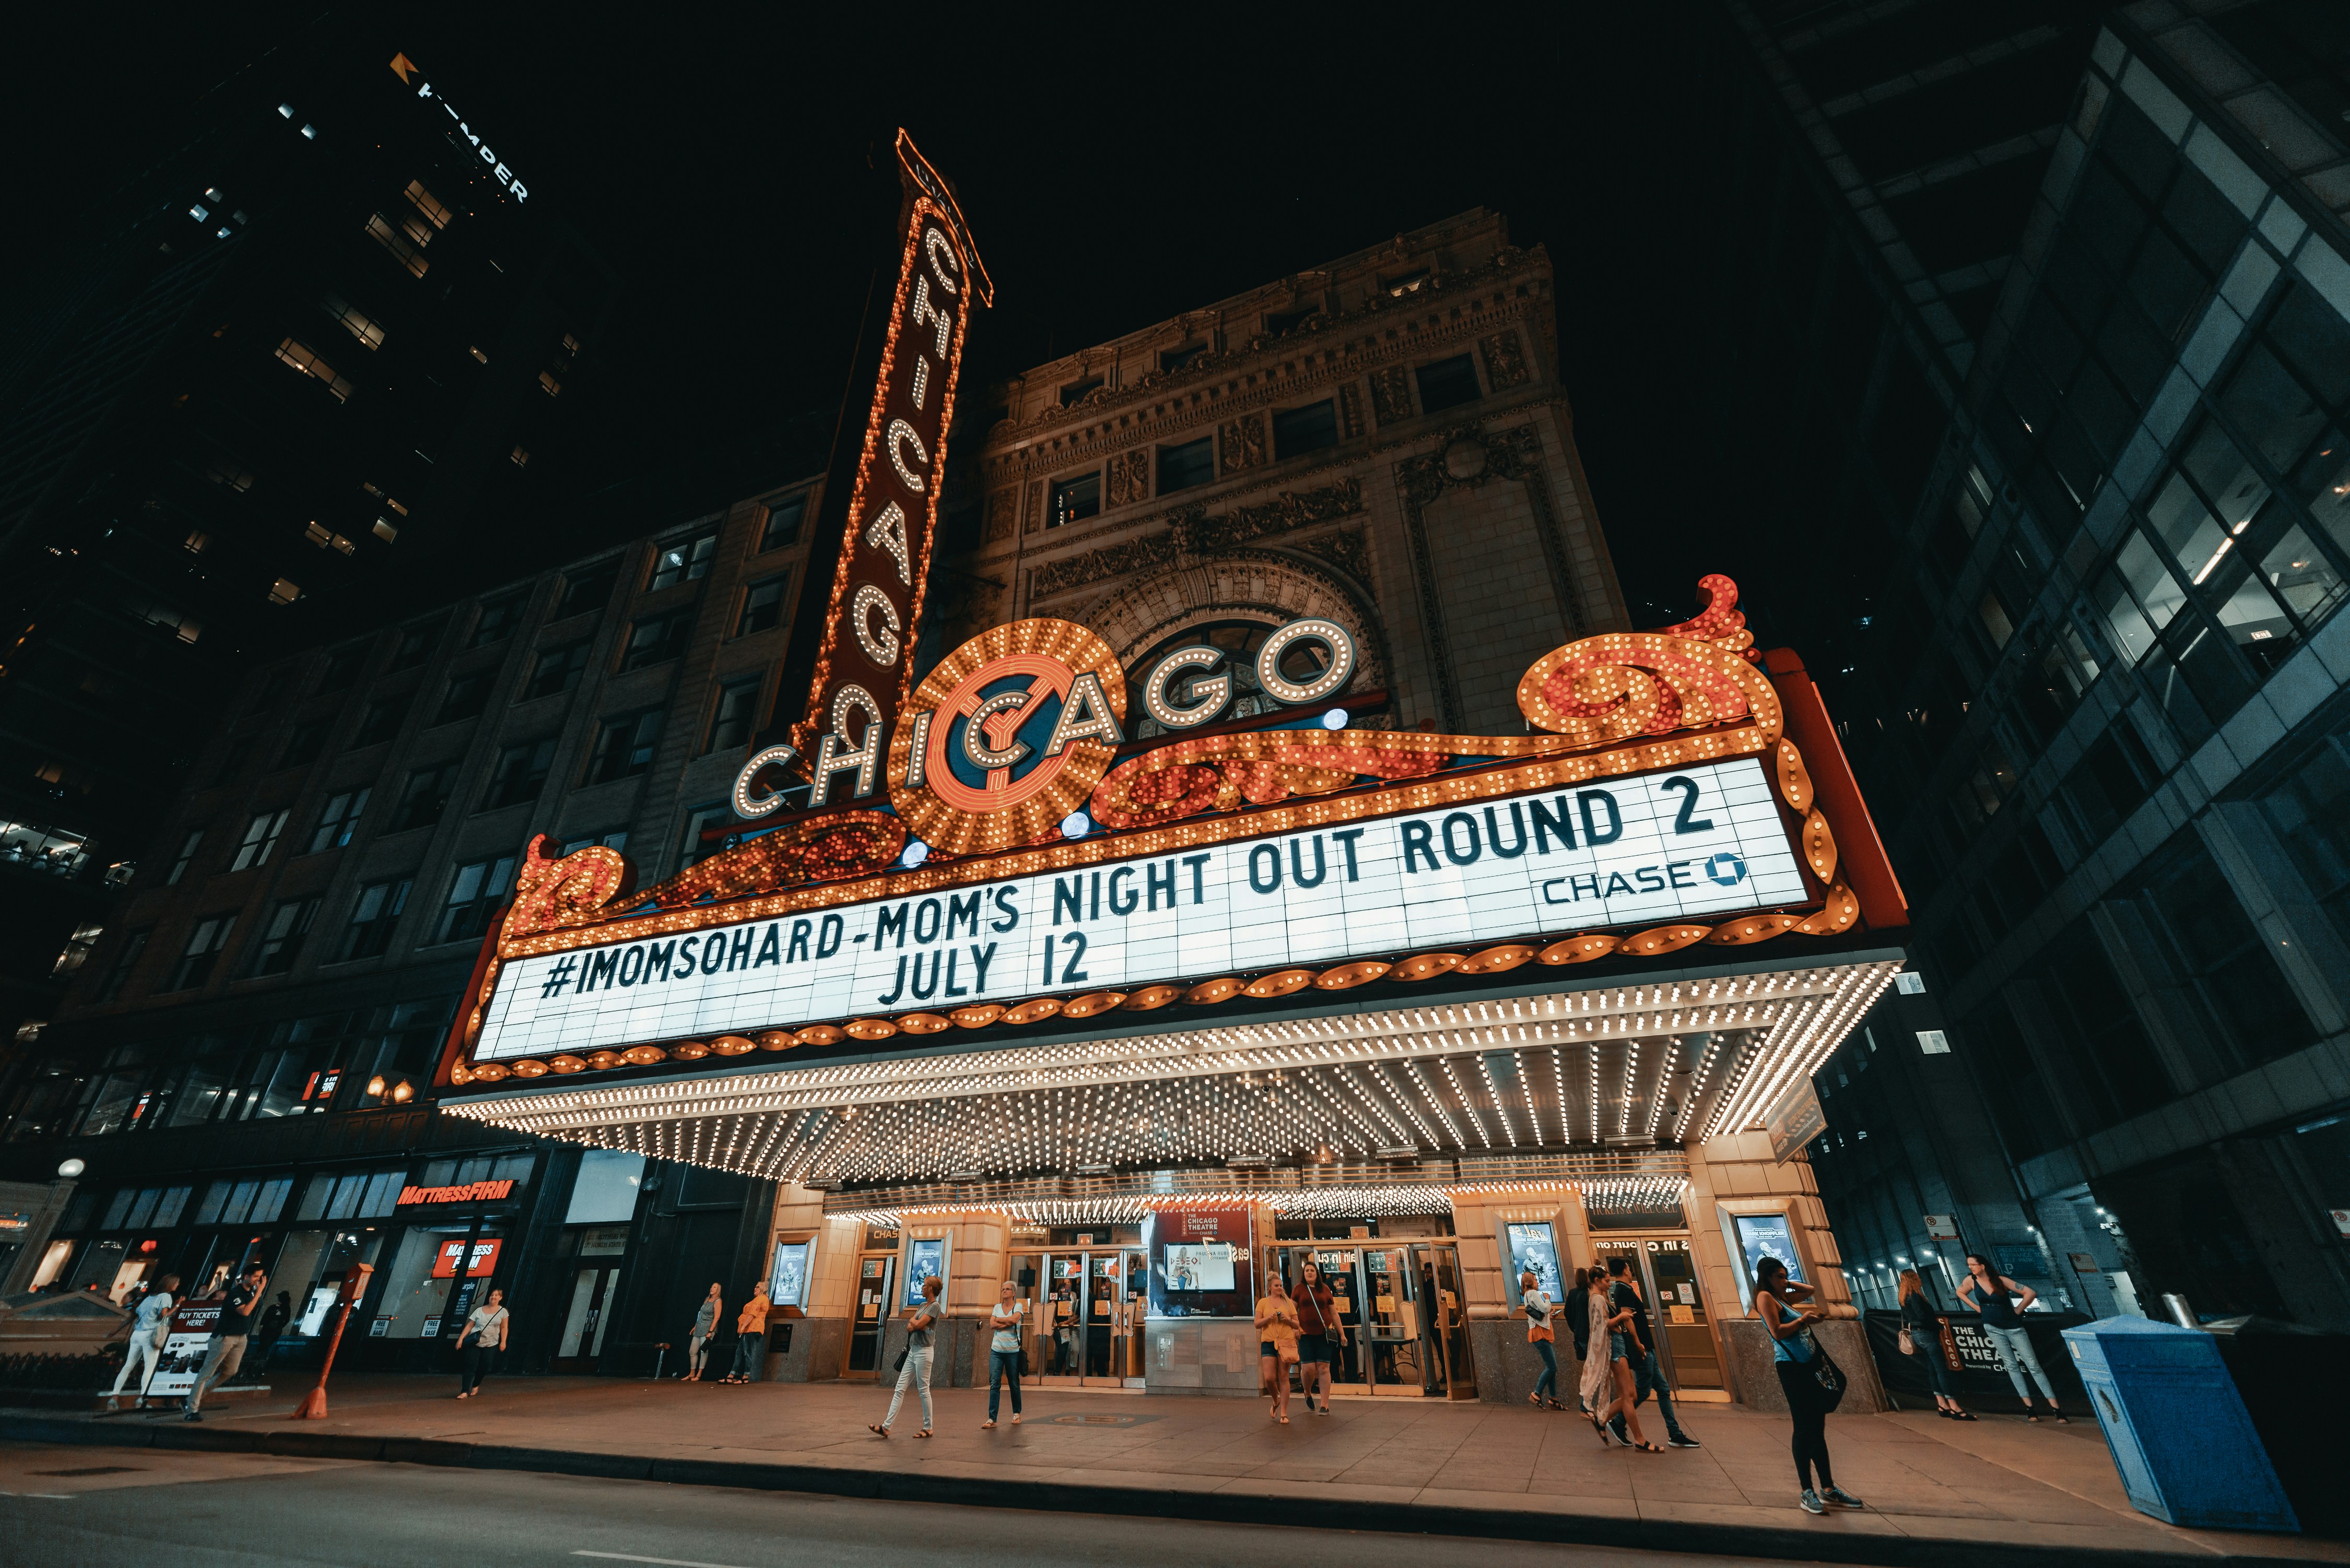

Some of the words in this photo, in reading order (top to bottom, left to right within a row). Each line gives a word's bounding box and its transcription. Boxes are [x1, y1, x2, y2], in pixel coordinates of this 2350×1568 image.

[832, 227, 959, 753] CHICAGO
[2253, 631, 2269, 639] EXIT
[732, 617, 1357, 819] CHICAGO
[1052, 852, 1212, 927] NIGHT
[1248, 827, 1365, 894] OUT
[1400, 787, 1624, 874] ROUND
[1660, 775, 1714, 835] 2
[1541, 860, 1699, 905] CHASE
[877, 942, 998, 1006] JULY
[1043, 932, 1089, 986] 12
[1592, 1203, 1624, 1215] TICKETS
[1633, 1202, 1654, 1214] WILL
[1655, 1202, 1677, 1213] CALL
[874, 1229, 899, 1239] CHAS
[445, 1244, 494, 1257] MATRESS
[452, 1256, 481, 1269] FM
[356, 1274, 368, 1296] FIRE
[462, 1282, 475, 1291] urple
[193, 1309, 220, 1319] TICKETS
[1953, 1326, 1975, 1335] THE
[1956, 1336, 2005, 1348] CHIC
[1993, 1364, 2027, 1373] CHE
